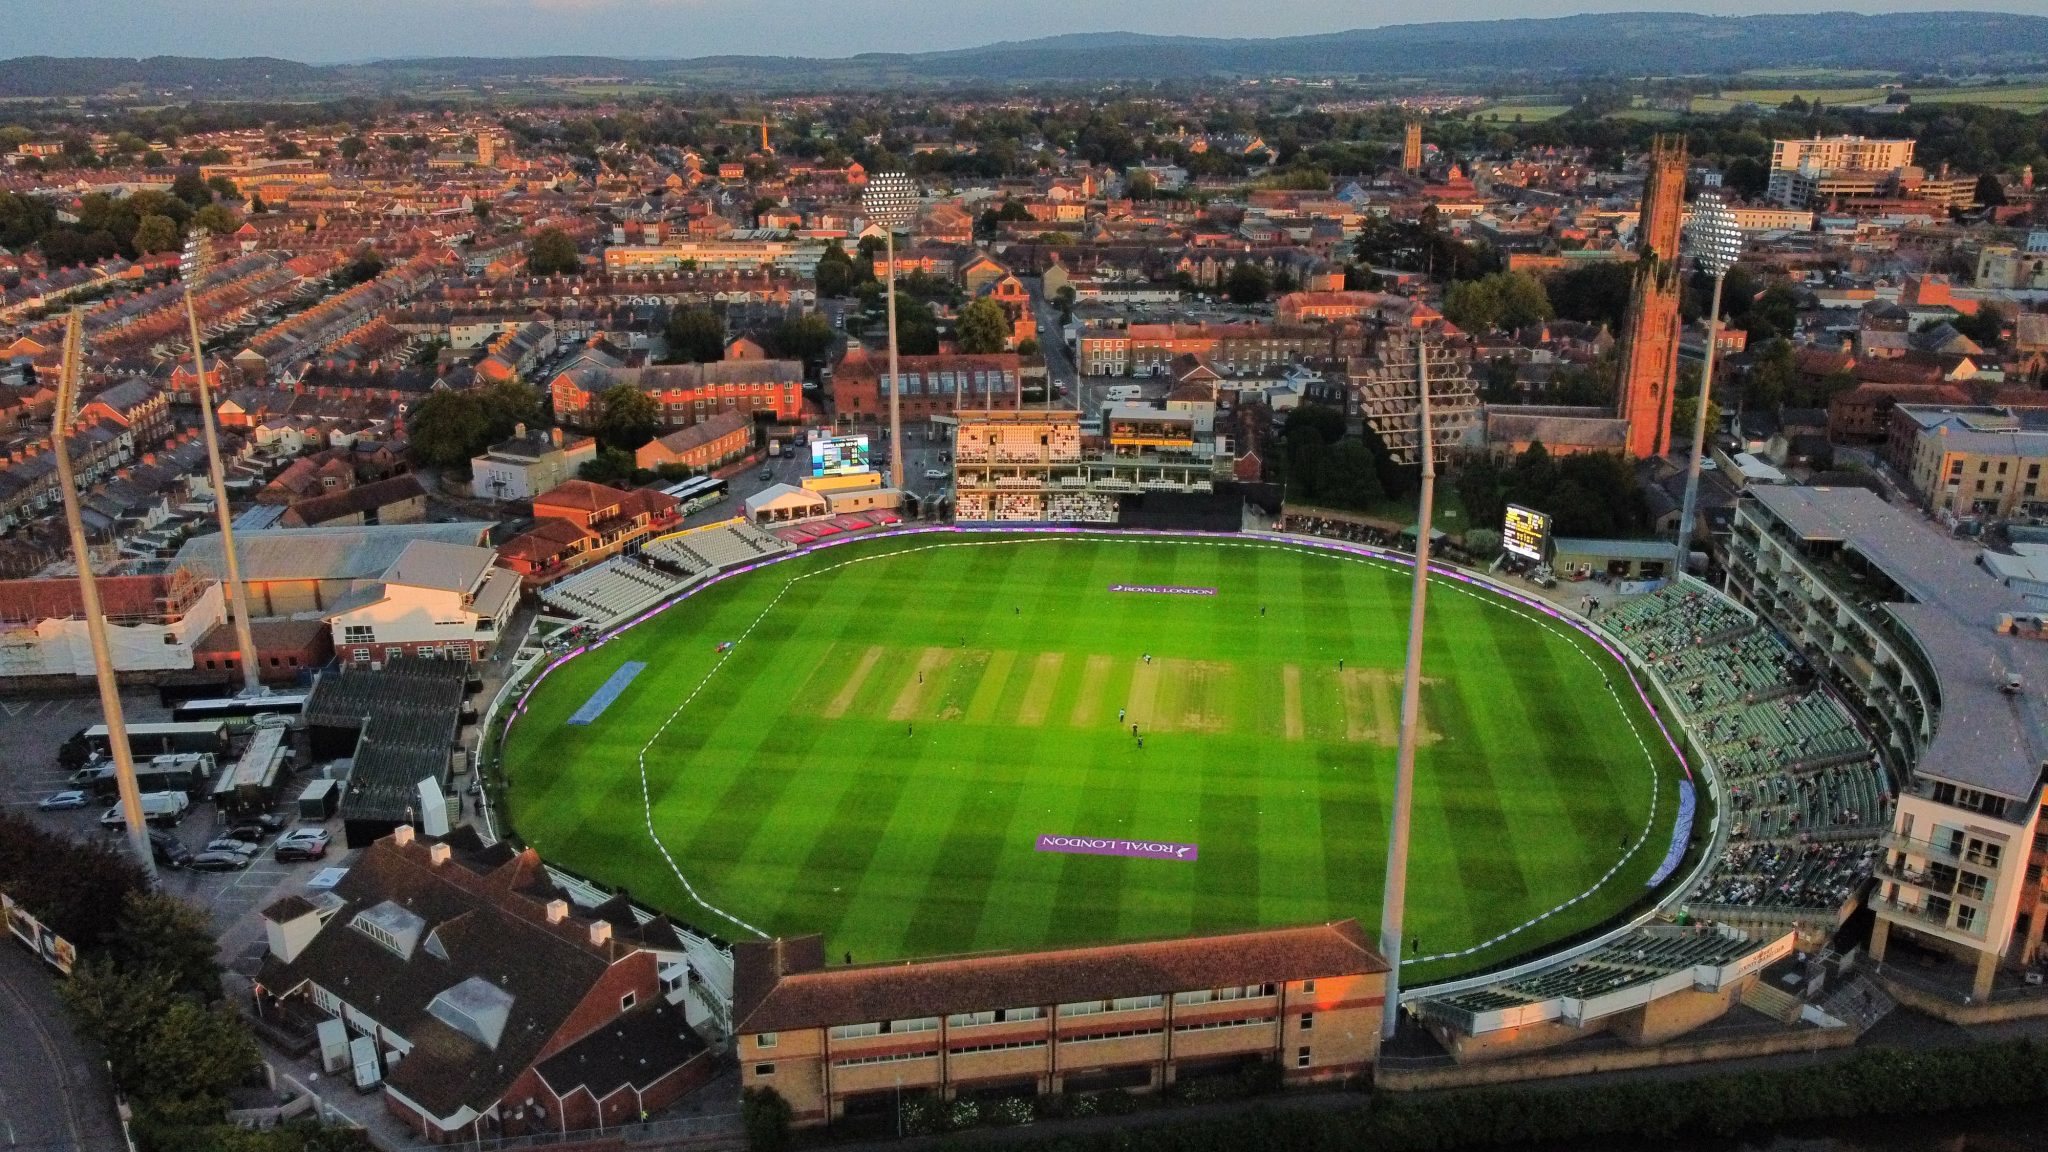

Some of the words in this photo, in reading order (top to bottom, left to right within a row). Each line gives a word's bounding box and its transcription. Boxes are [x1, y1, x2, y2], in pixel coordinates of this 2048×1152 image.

[1163, 587, 1213, 595] LONDON
[1043, 837, 1115, 849] LONDON
[1121, 841, 1174, 853] ROYAL
